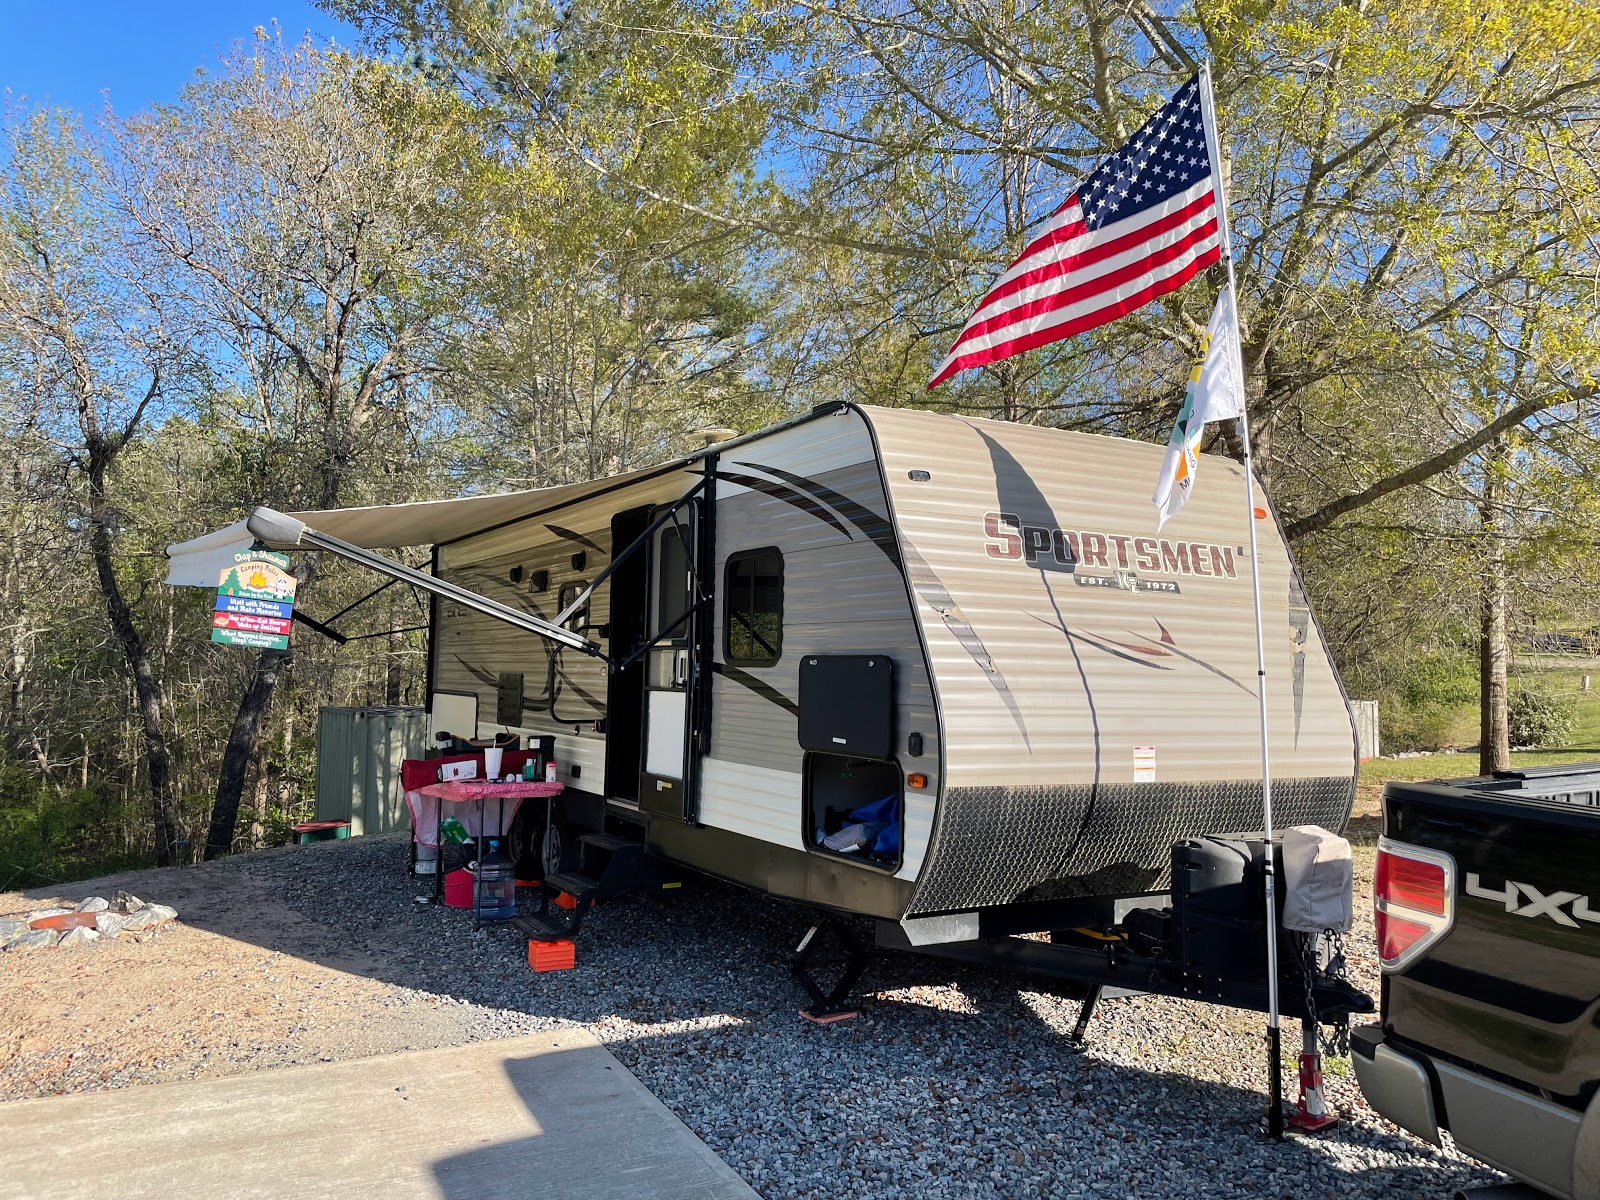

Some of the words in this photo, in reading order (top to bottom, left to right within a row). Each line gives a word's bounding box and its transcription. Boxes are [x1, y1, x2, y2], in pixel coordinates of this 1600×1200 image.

[982, 511, 1238, 579] SPORTSMEN
[235, 553, 251, 562] Chip
[253, 550, 257, 558] &
[241, 563, 263, 572] Camping
[265, 565, 279, 576] Rules
[1080, 576, 1108, 586] EST.
[1145, 581, 1176, 591] 1972
[230, 598, 245, 606] Visit
[258, 601, 279, 610] Friends
[239, 605, 255, 614] Make
[256, 607, 282, 617] Memories
[228, 614, 239, 622] Nap
[260, 624, 281, 632] Smiling
[220, 629, 237, 637] What
[237, 631, 258, 640] Happens
